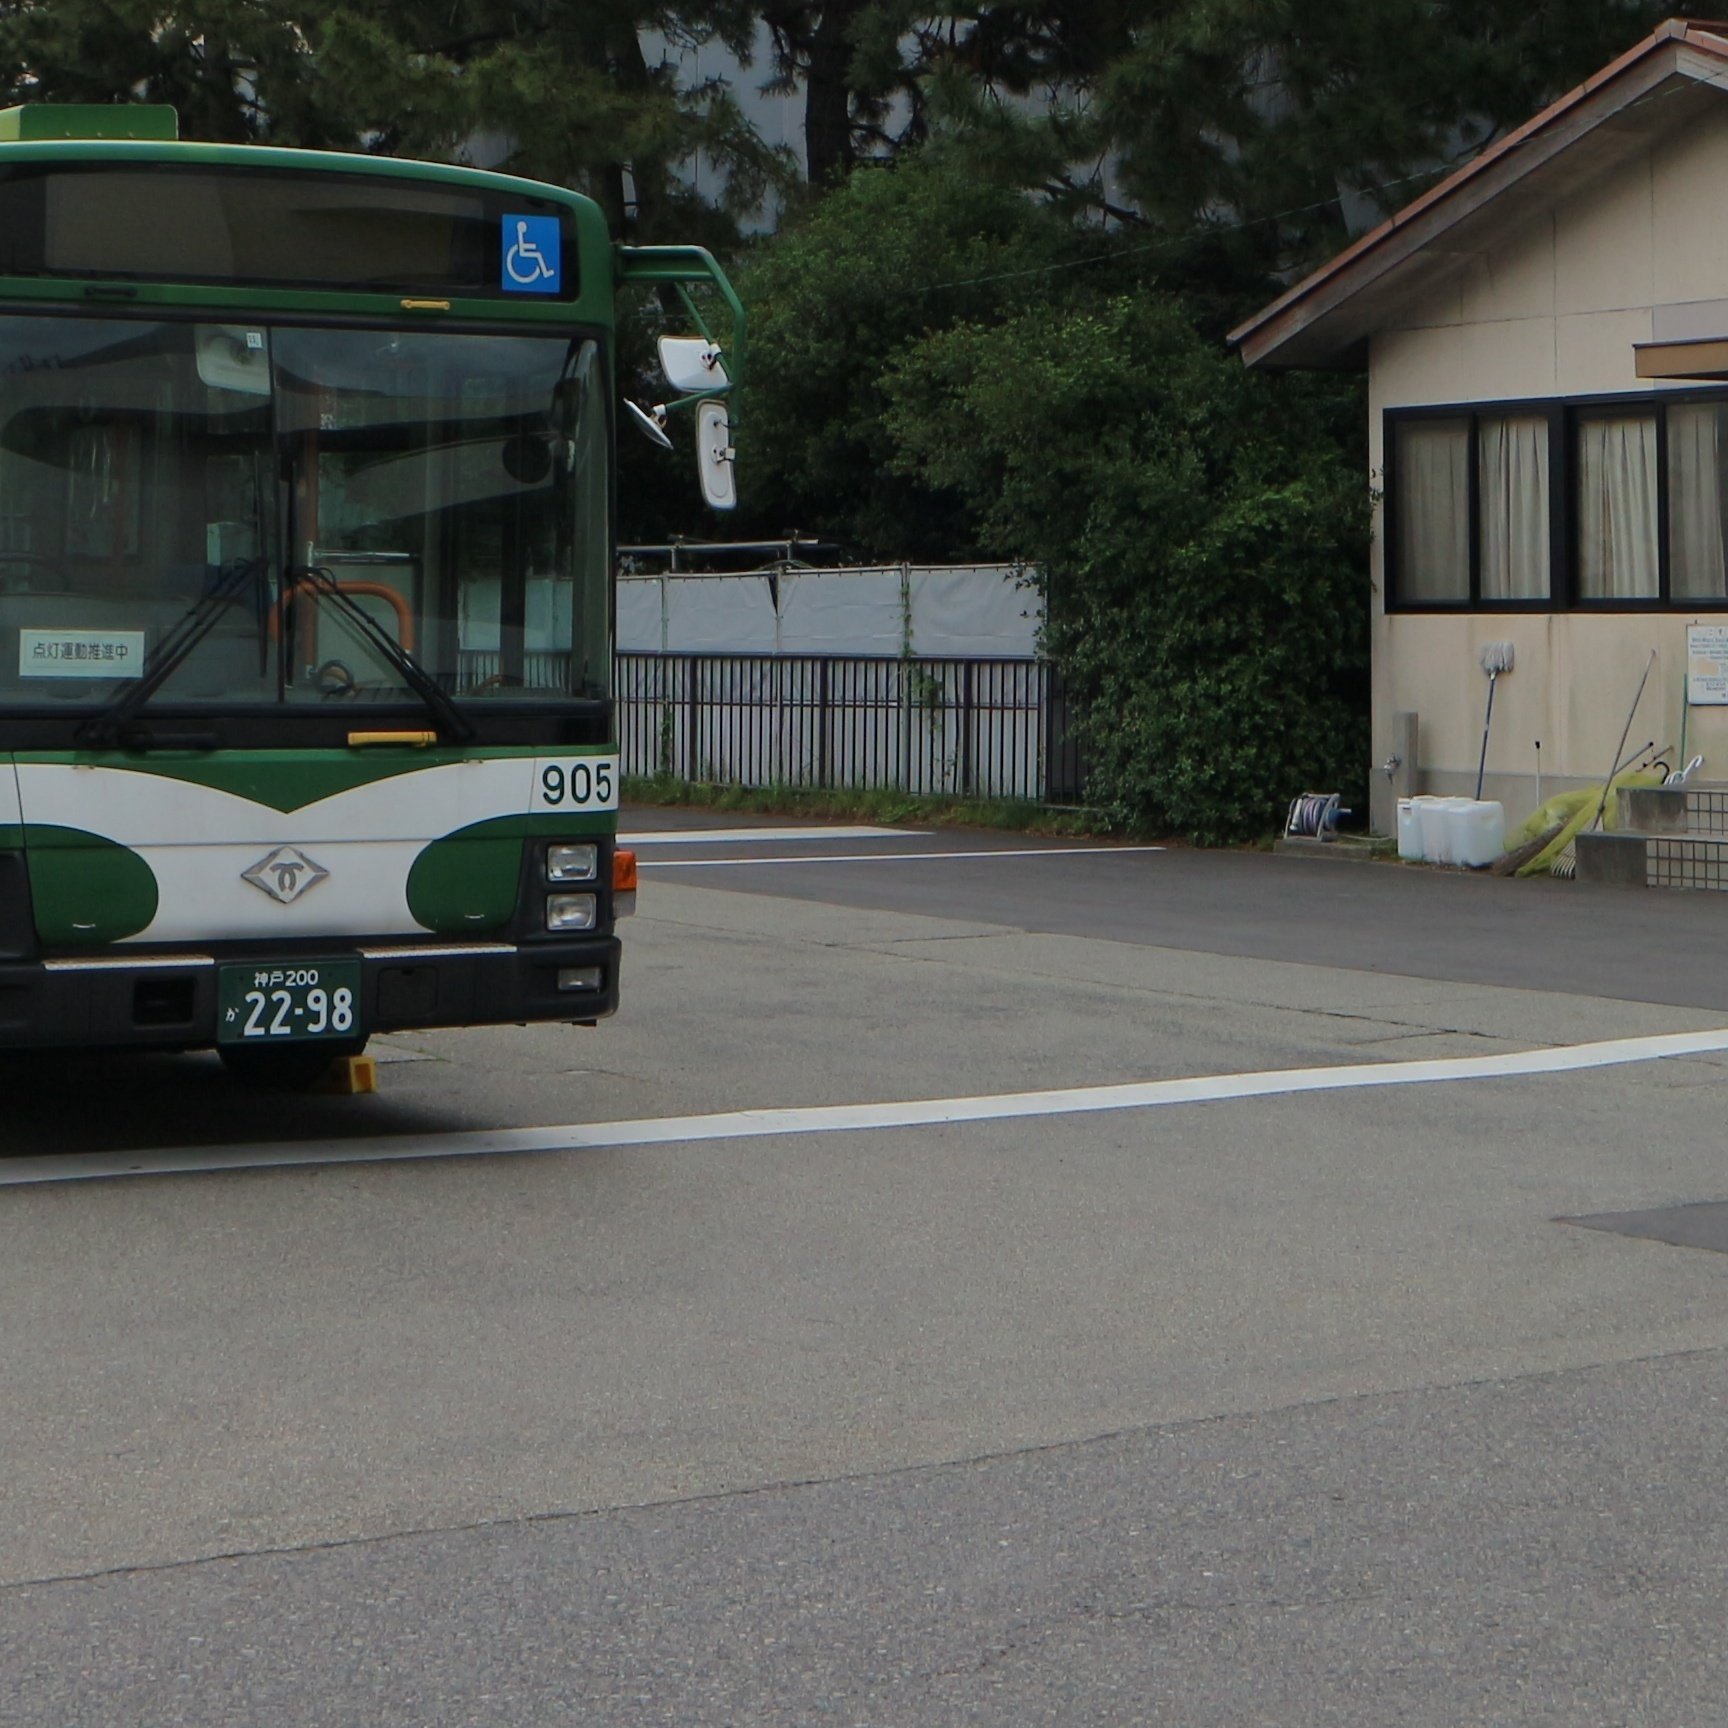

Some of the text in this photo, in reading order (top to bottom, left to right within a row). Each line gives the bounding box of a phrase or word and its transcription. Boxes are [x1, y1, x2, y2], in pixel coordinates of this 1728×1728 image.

[32, 642, 128, 661] 点灯運動推進中
[542, 763, 611, 805] 905
[254, 969, 319, 988] 神戸200
[243, 987, 353, 1036] 22-98
